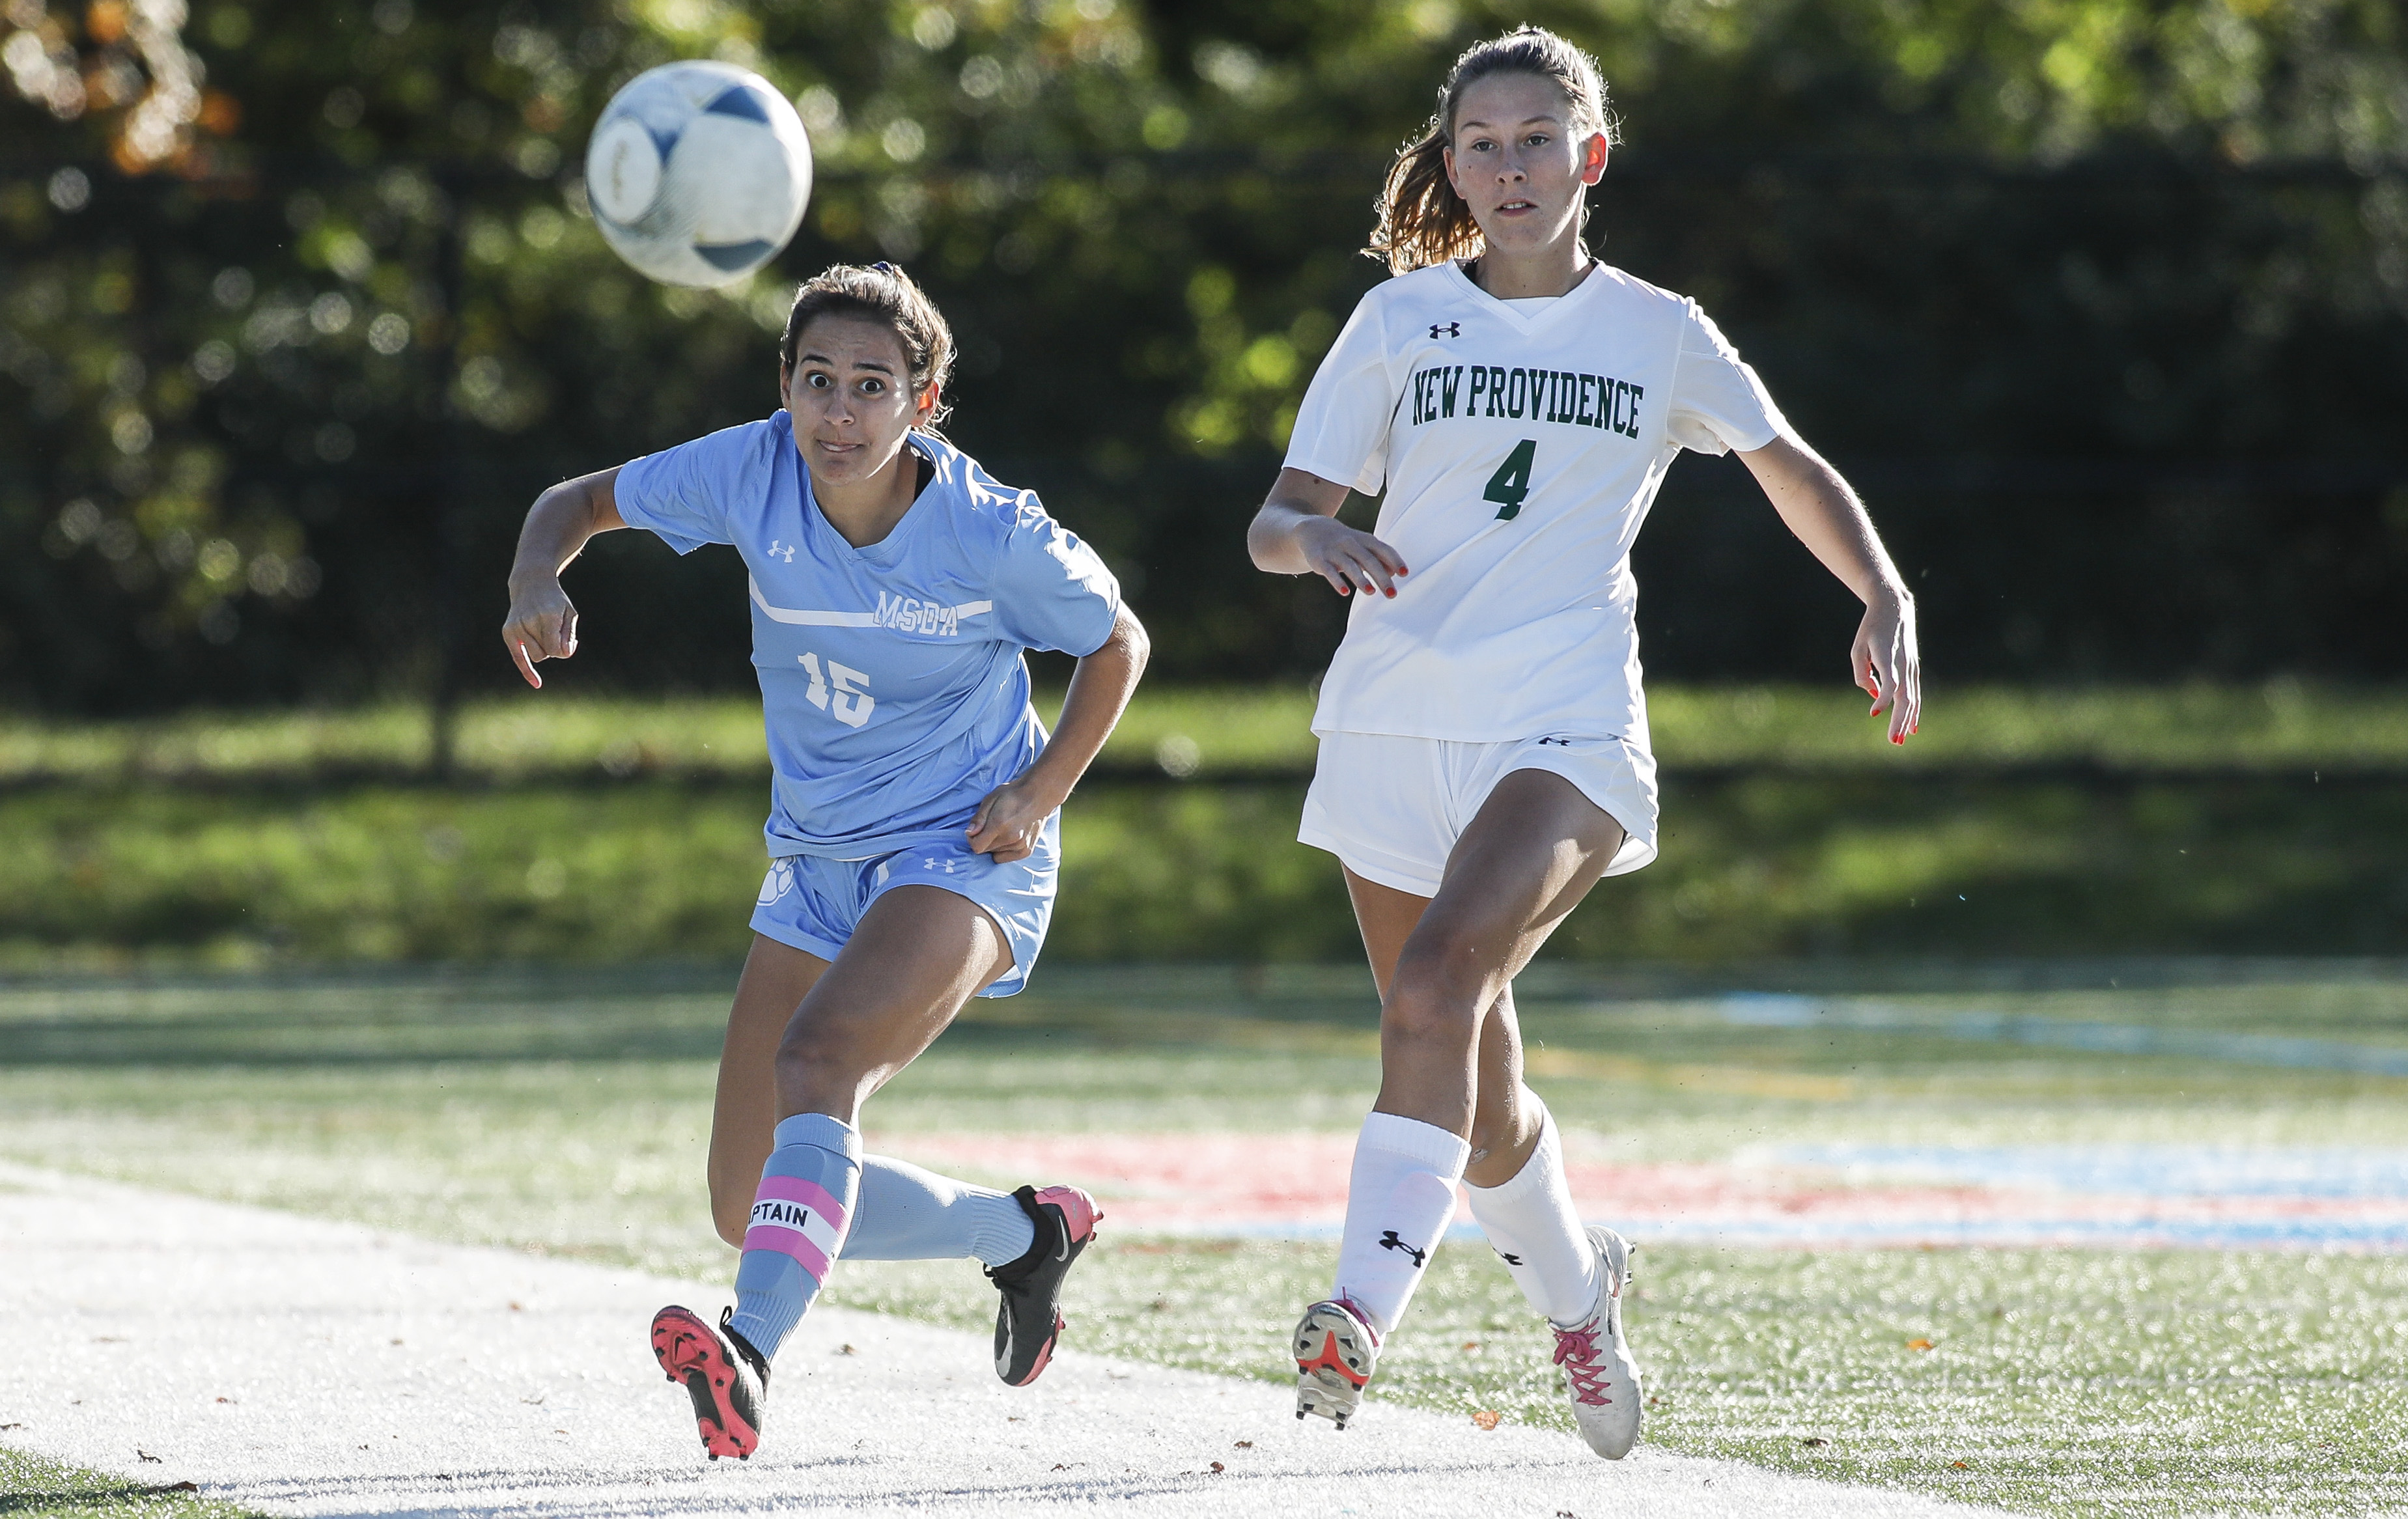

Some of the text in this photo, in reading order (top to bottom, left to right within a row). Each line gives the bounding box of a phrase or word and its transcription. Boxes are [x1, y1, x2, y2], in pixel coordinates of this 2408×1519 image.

[1413, 365, 1644, 439] NEW PROVIDENCE
[1483, 439, 1537, 521] 4
[873, 591, 958, 636] MSDA
[798, 652, 875, 728] 15
[749, 1203, 808, 1227] PTAIN
